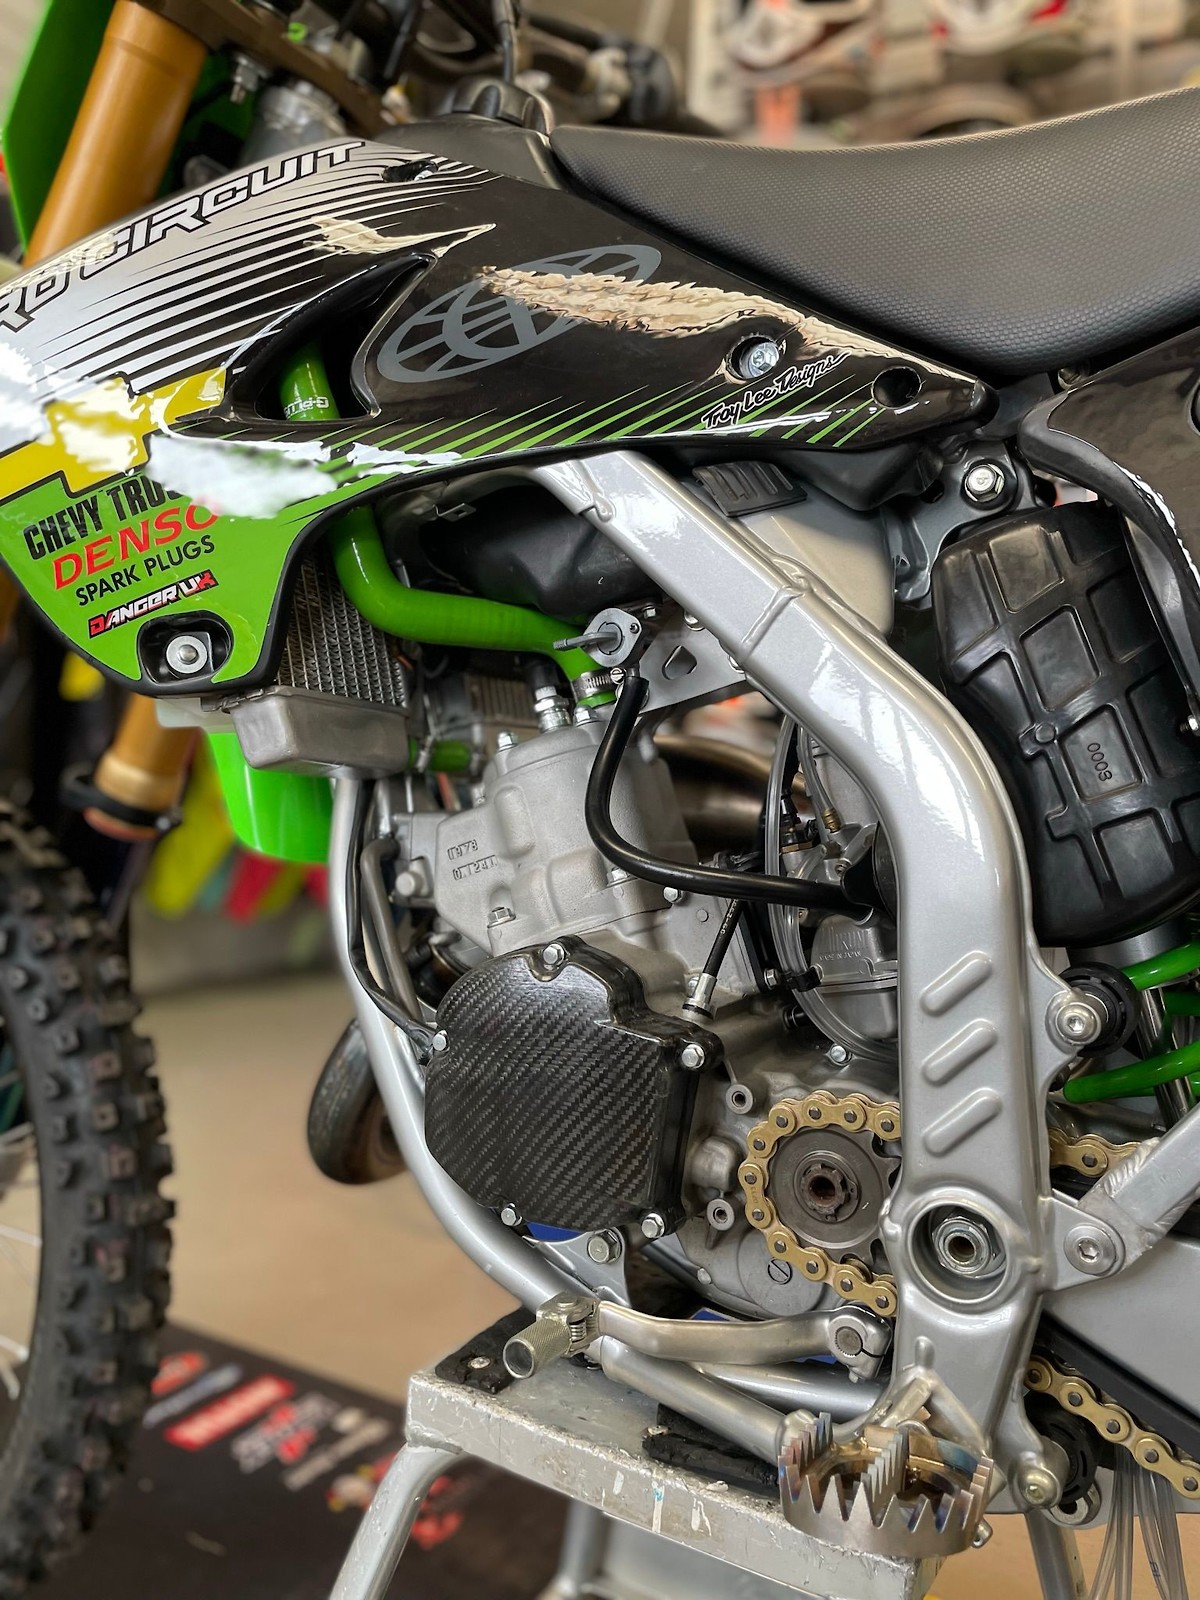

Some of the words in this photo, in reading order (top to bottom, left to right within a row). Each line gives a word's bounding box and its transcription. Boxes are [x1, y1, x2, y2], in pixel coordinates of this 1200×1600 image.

[79, 141, 366, 281] CIRCUIT
[701, 401, 742, 429] Troy
[743, 385, 778, 412] Lee
[773, 351, 852, 393] Designs
[23, 492, 104, 560] CHEVY
[106, 475, 185, 522] TRU
[52, 501, 220, 591] DENSO
[75, 564, 141, 606] SPARK
[143, 535, 215, 577] PLUGS
